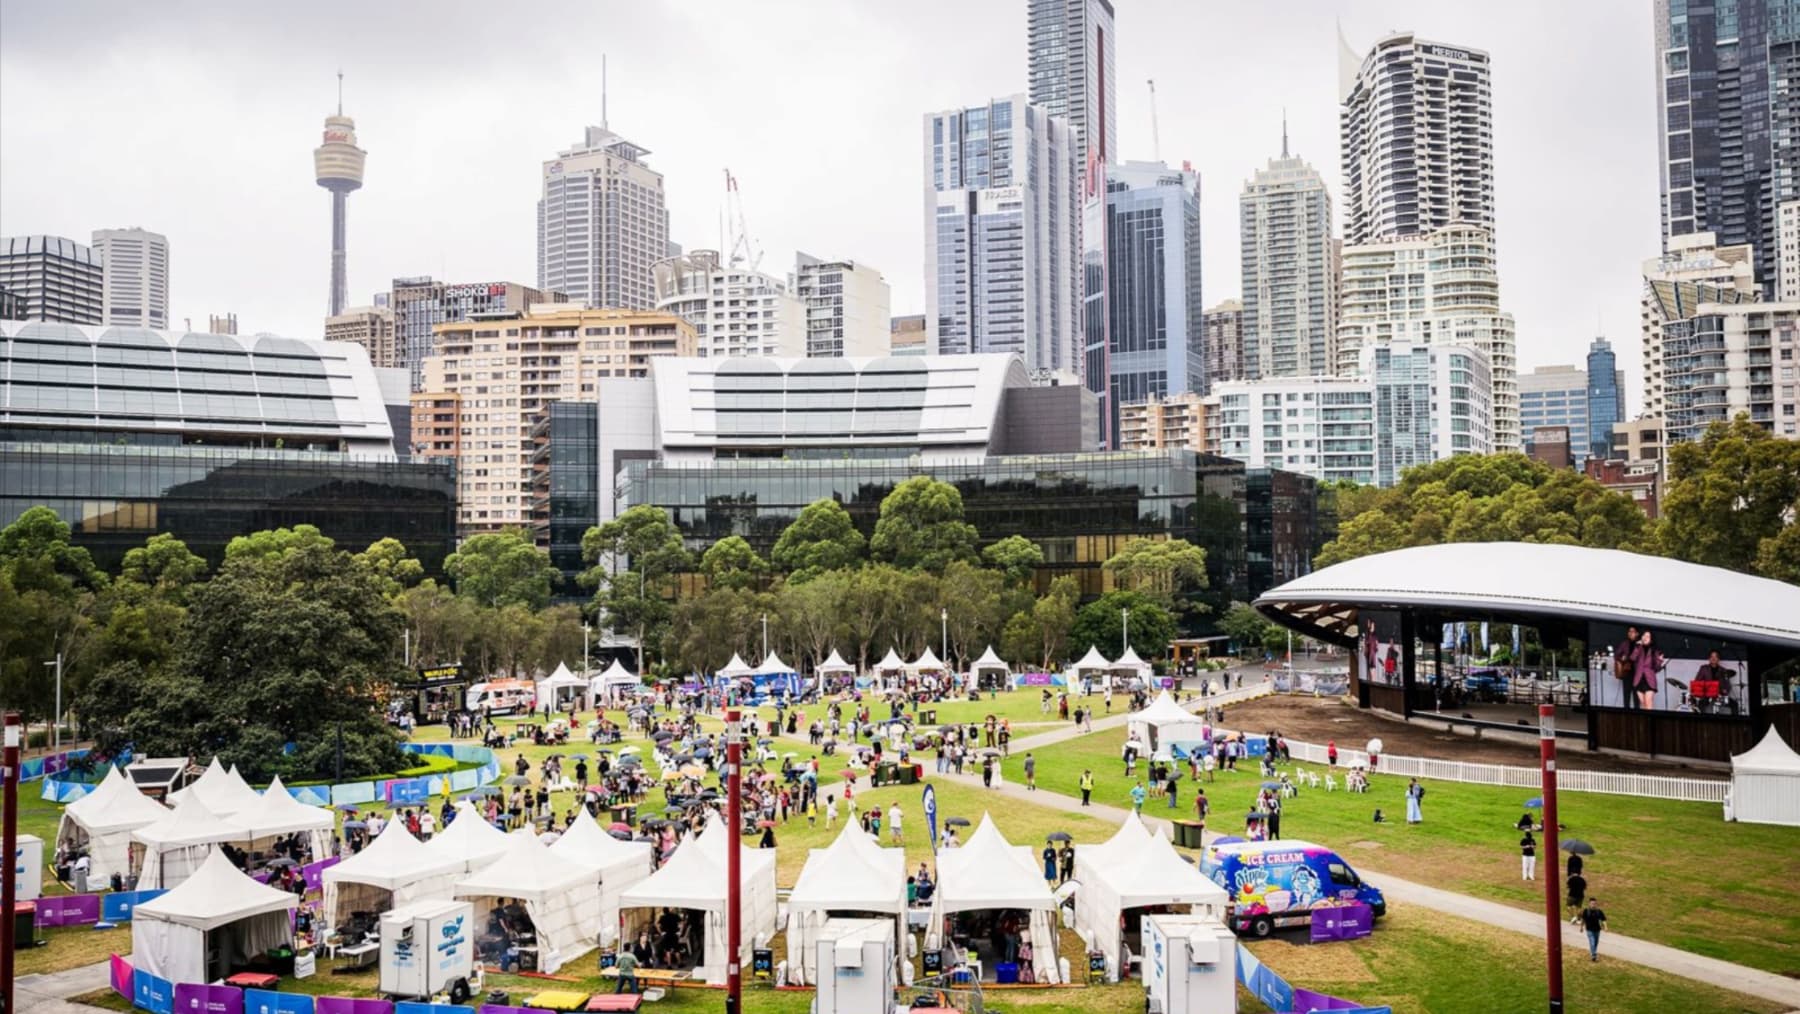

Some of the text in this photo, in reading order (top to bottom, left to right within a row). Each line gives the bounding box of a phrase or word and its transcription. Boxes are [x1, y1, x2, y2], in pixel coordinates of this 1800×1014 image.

[1431, 46, 1470, 61] MERITON
[1247, 852, 1305, 866] ICE CREAM
